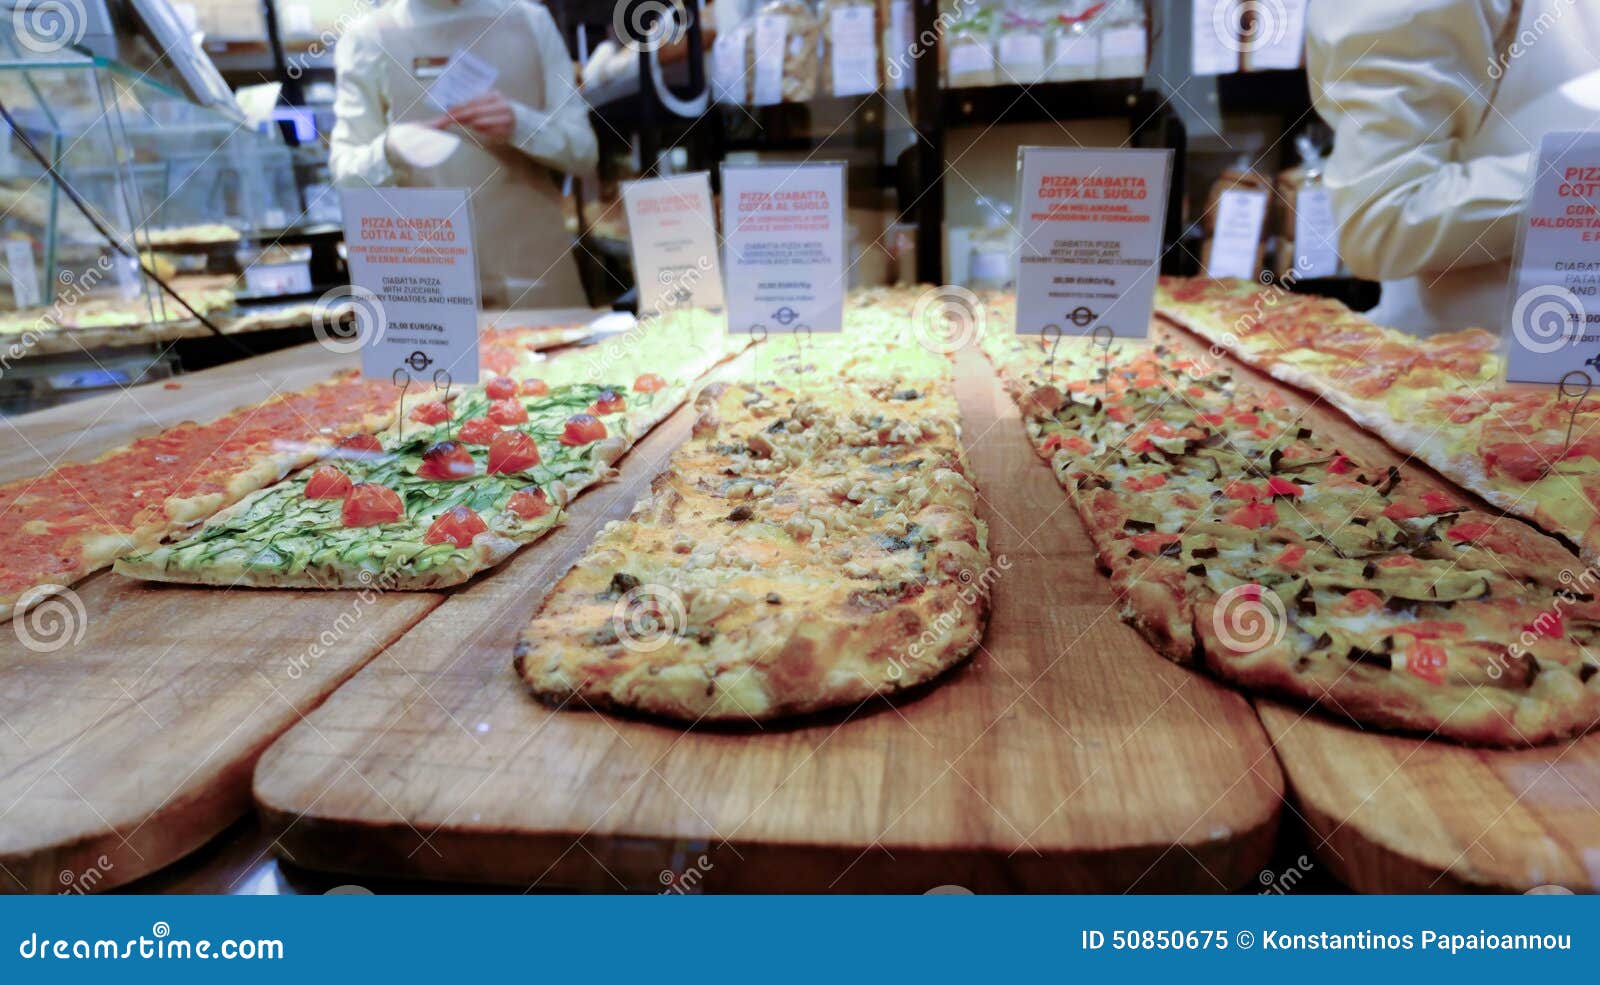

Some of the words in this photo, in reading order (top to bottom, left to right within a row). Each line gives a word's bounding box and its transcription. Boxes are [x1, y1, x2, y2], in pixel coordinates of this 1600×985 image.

[1041, 176, 1078, 187] PIZZA
[1081, 177, 1146, 188] CIABATTA
[739, 191, 771, 201] PIZZA
[773, 191, 827, 200] CIABATTA
[1038, 188, 1081, 199] COTTA
[1084, 189, 1100, 199] AL
[1104, 189, 1147, 200] SUOLO
[738, 202, 773, 212] COTTA
[776, 202, 789, 211] AL
[1566, 204, 1596, 215] CON
[361, 218, 395, 228] PIZZA
[397, 218, 452, 229] CIABATTA
[361, 230, 396, 240] COTTA
[400, 230, 414, 241] AL
[417, 230, 456, 242] SUOLO
[381, 276, 418, 286] CIABATTA
[419, 277, 441, 287] PIZZA
[382, 286, 402, 294] WITH
[388, 294, 427, 304] TOMATOES
[427, 295, 445, 305] AND
